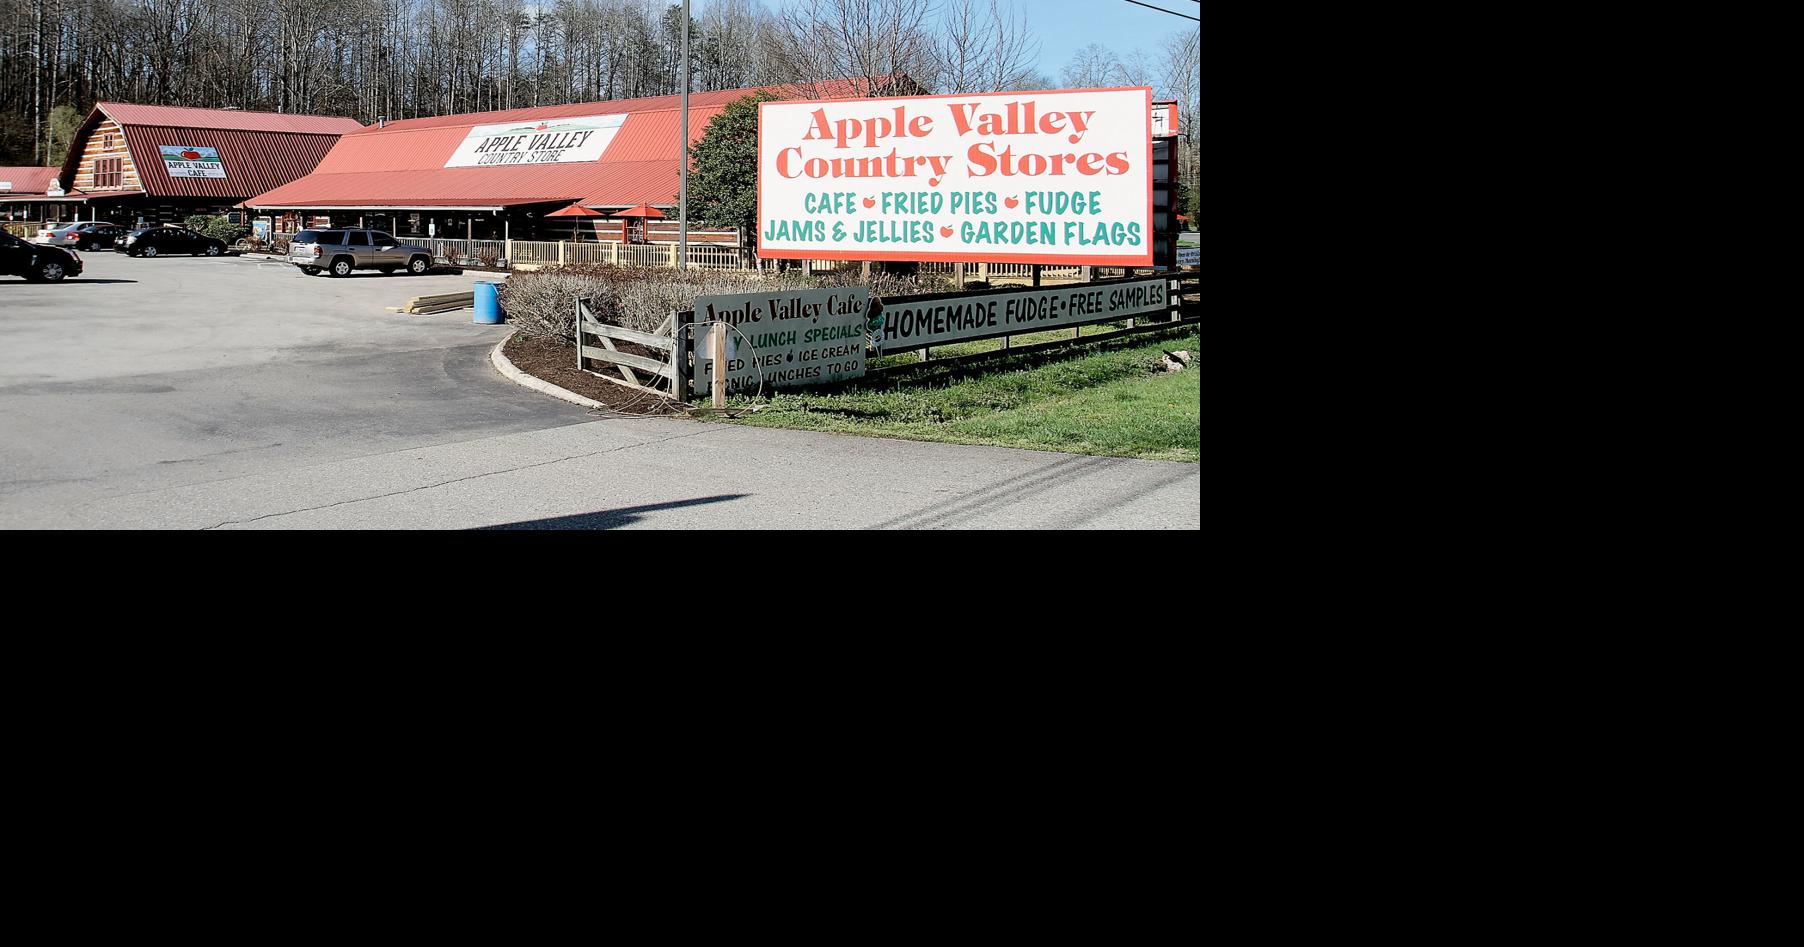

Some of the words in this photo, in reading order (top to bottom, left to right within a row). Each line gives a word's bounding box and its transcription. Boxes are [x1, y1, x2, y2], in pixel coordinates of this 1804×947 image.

[802, 106, 934, 148] Apple
[947, 100, 1096, 144] Valley
[475, 135, 527, 153] APPLE
[528, 130, 594, 150] VALLEY
[478, 152, 528, 164] COUNTRY
[527, 150, 566, 162] STORE
[775, 146, 953, 187] Country
[966, 139, 1130, 179] Stores
[804, 191, 858, 215] CAFE
[881, 191, 943, 215] FRIED
[950, 191, 998, 215] PIES
[1024, 190, 1102, 216] FUDGE
[764, 219, 826, 242] JAMS
[831, 222, 847, 242] &
[853, 219, 935, 244] JELLIES
[960, 220, 1057, 246] GARDEN
[1063, 220, 1141, 247] FLAGS
[701, 301, 763, 331] Apple
[768, 297, 823, 324] Valley
[827, 293, 863, 316] Cafe
[882, 300, 998, 341] HOMEMADE
[1005, 294, 1060, 325] FUDGE
[1068, 289, 1103, 317] FREE
[1108, 284, 1164, 312] SAMPLES
[750, 330, 797, 350] LUNCH
[804, 323, 863, 344] SPECIALS
[704, 359, 745, 376] FED
[752, 352, 783, 369] PIES
[798, 347, 819, 363] ICE
[821, 343, 860, 359] CREAM
[706, 373, 754, 393] PCNIC
[827, 362, 841, 375] TO
[844, 359, 859, 372] GO
